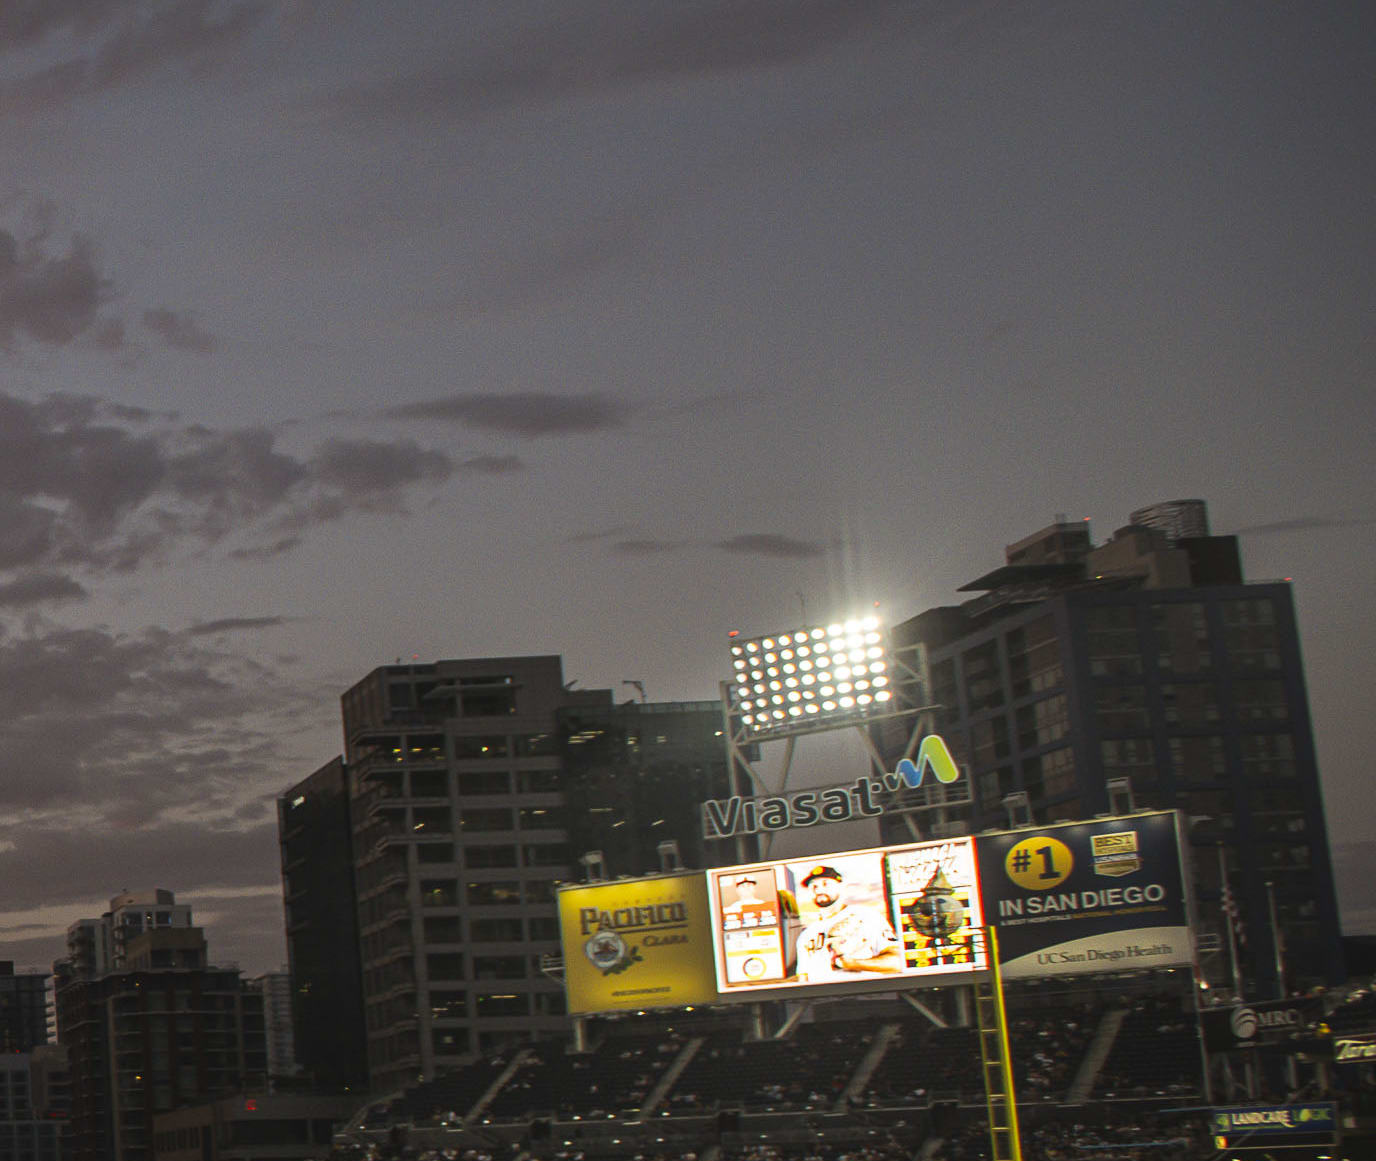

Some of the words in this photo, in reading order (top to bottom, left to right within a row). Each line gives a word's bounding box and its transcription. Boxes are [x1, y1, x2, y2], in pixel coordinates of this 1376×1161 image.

[705, 776, 883, 837] Viasat
[1012, 846, 1062, 880] #1
[1000, 899, 1023, 917] IN
[1027, 893, 1078, 914] SAN
[1082, 884, 1165, 908] DIEGO
[1037, 952, 1058, 965] UC
[1058, 950, 1087, 963] San
[1087, 948, 1125, 963] Diego
[1126, 944, 1173, 957] Health
